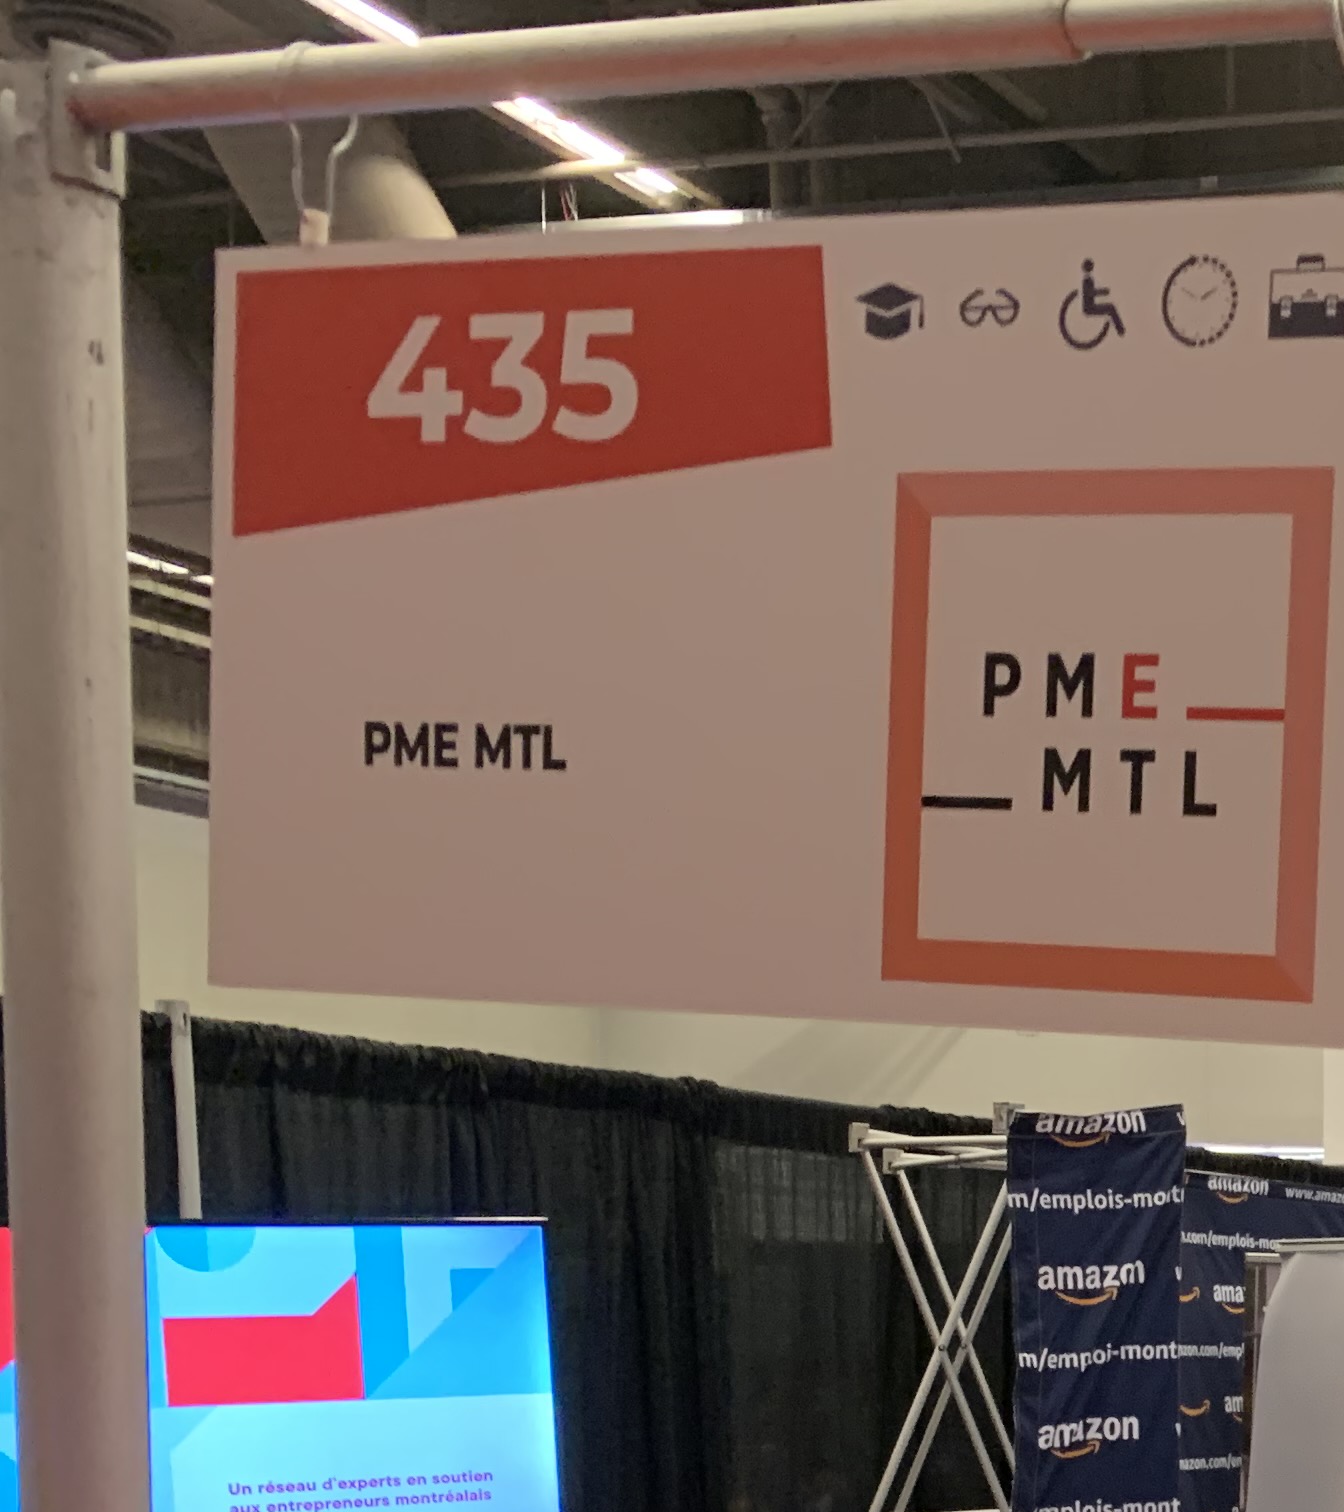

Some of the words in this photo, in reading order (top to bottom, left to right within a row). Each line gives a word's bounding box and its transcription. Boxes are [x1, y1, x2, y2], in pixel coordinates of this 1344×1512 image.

[366, 308, 638, 443] 435
[983, 652, 1160, 720] PME
[363, 721, 458, 769] PME
[474, 724, 568, 771] MTL
[1041, 748, 1218, 818] MTL
[1035, 1111, 1146, 1135] amazon
[228, 1483, 252, 1495] Un
[258, 1480, 317, 1495] réseau
[406, 1476, 427, 1486] en
[432, 1470, 493, 1484] soutien
[395, 1488, 492, 1507] montréalais
